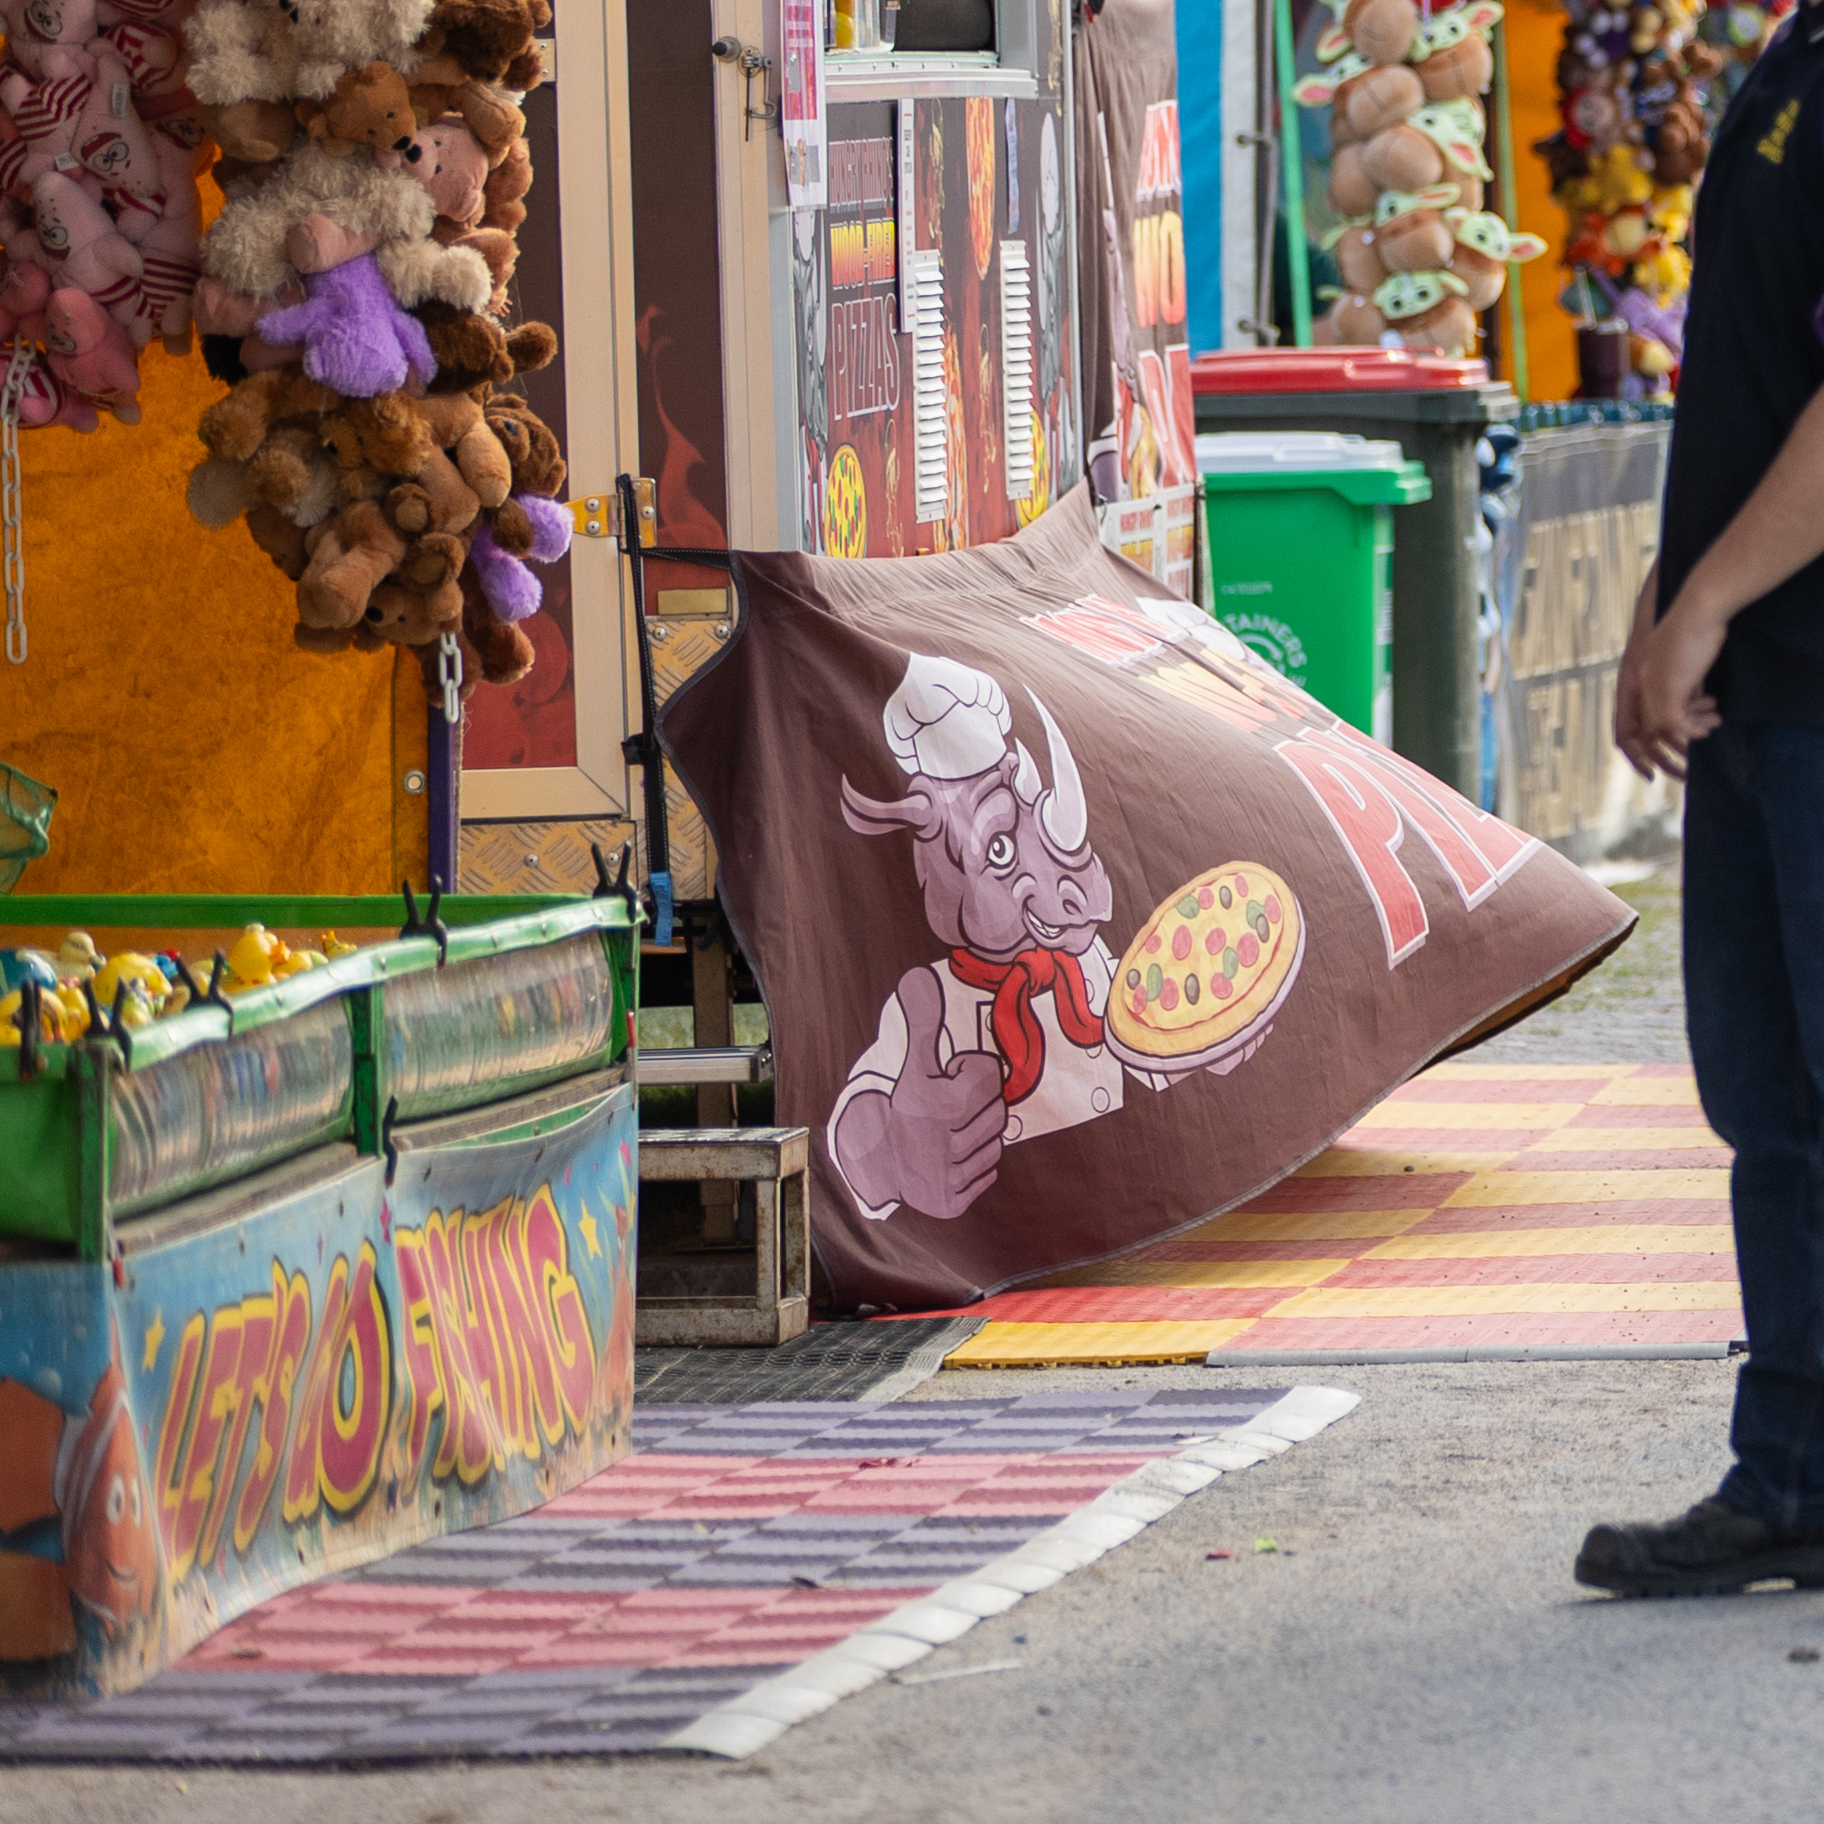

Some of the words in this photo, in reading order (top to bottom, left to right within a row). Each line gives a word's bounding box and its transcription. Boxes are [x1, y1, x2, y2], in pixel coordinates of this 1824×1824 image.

[831, 292, 900, 421] PIZZAS
[1223, 612, 1307, 669] TAINERS
[155, 1254, 312, 1581] LET'S
[283, 1237, 395, 1524] GO
[394, 1181, 597, 1500] FISHING
